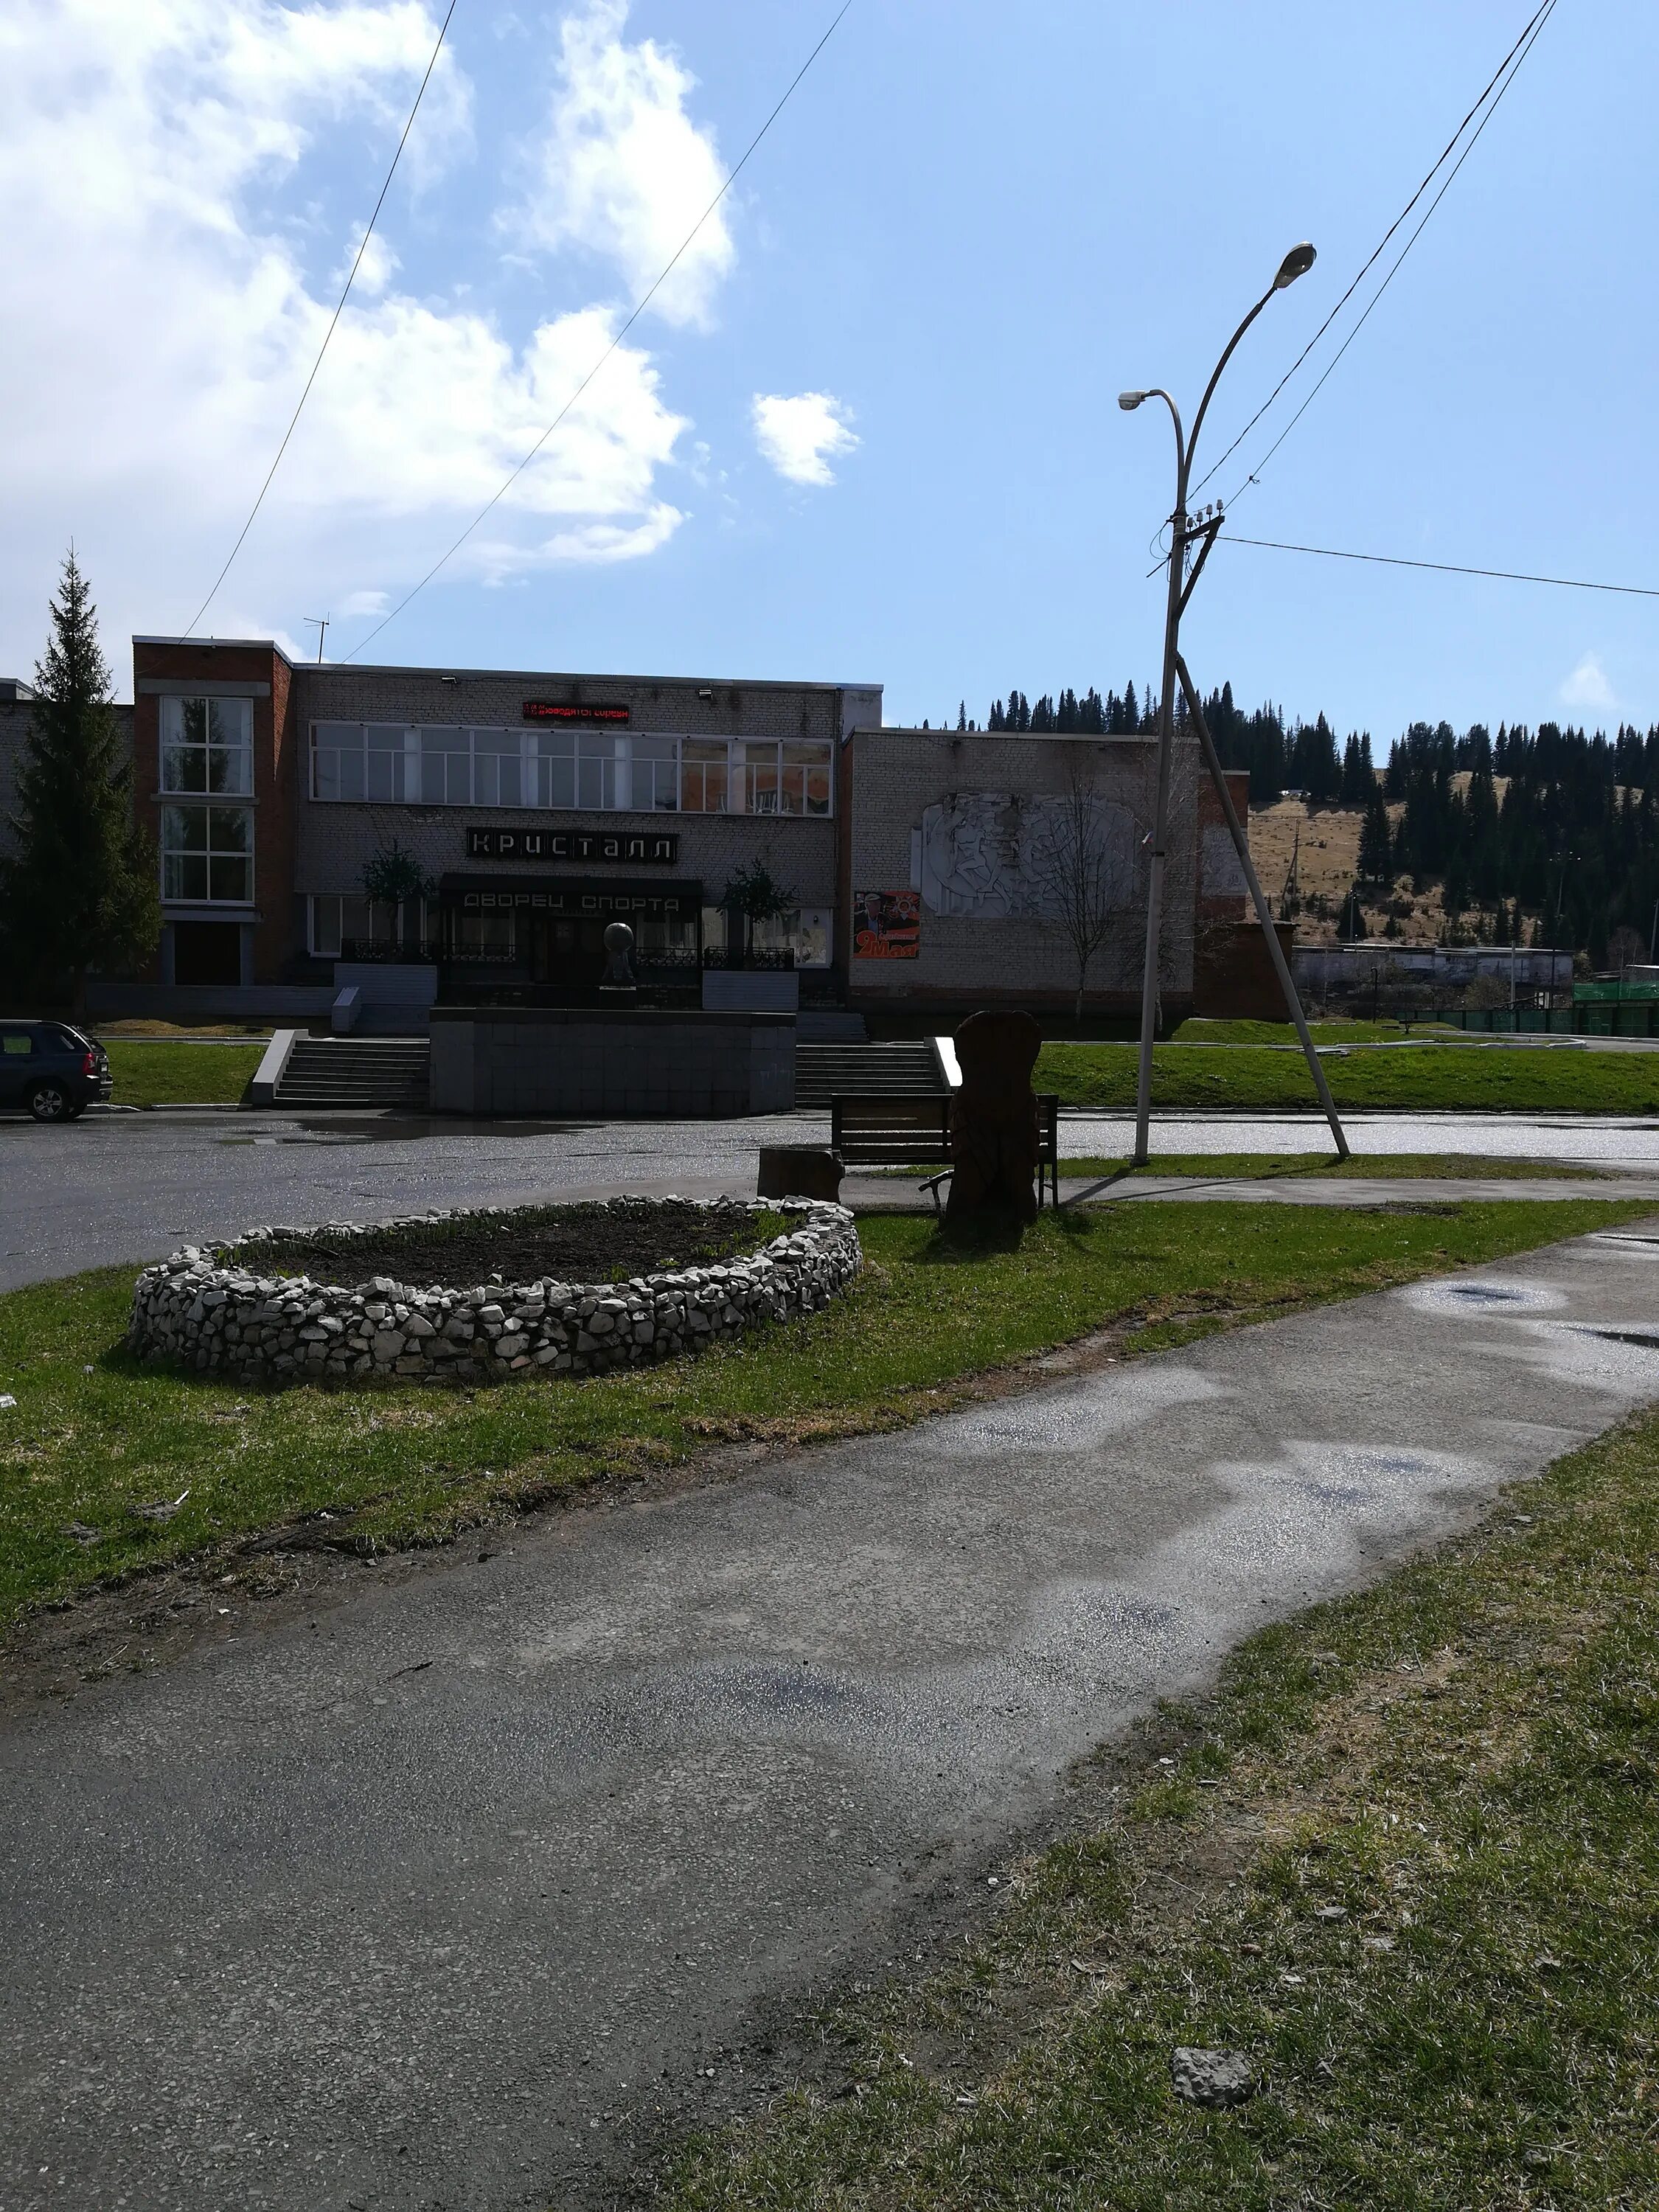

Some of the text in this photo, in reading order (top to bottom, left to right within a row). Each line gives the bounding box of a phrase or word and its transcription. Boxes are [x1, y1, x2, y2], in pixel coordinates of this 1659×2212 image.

[464, 893, 679, 911] ДВОРЕЦ СПОРТА
[856, 930, 919, 958] 9 Мая
